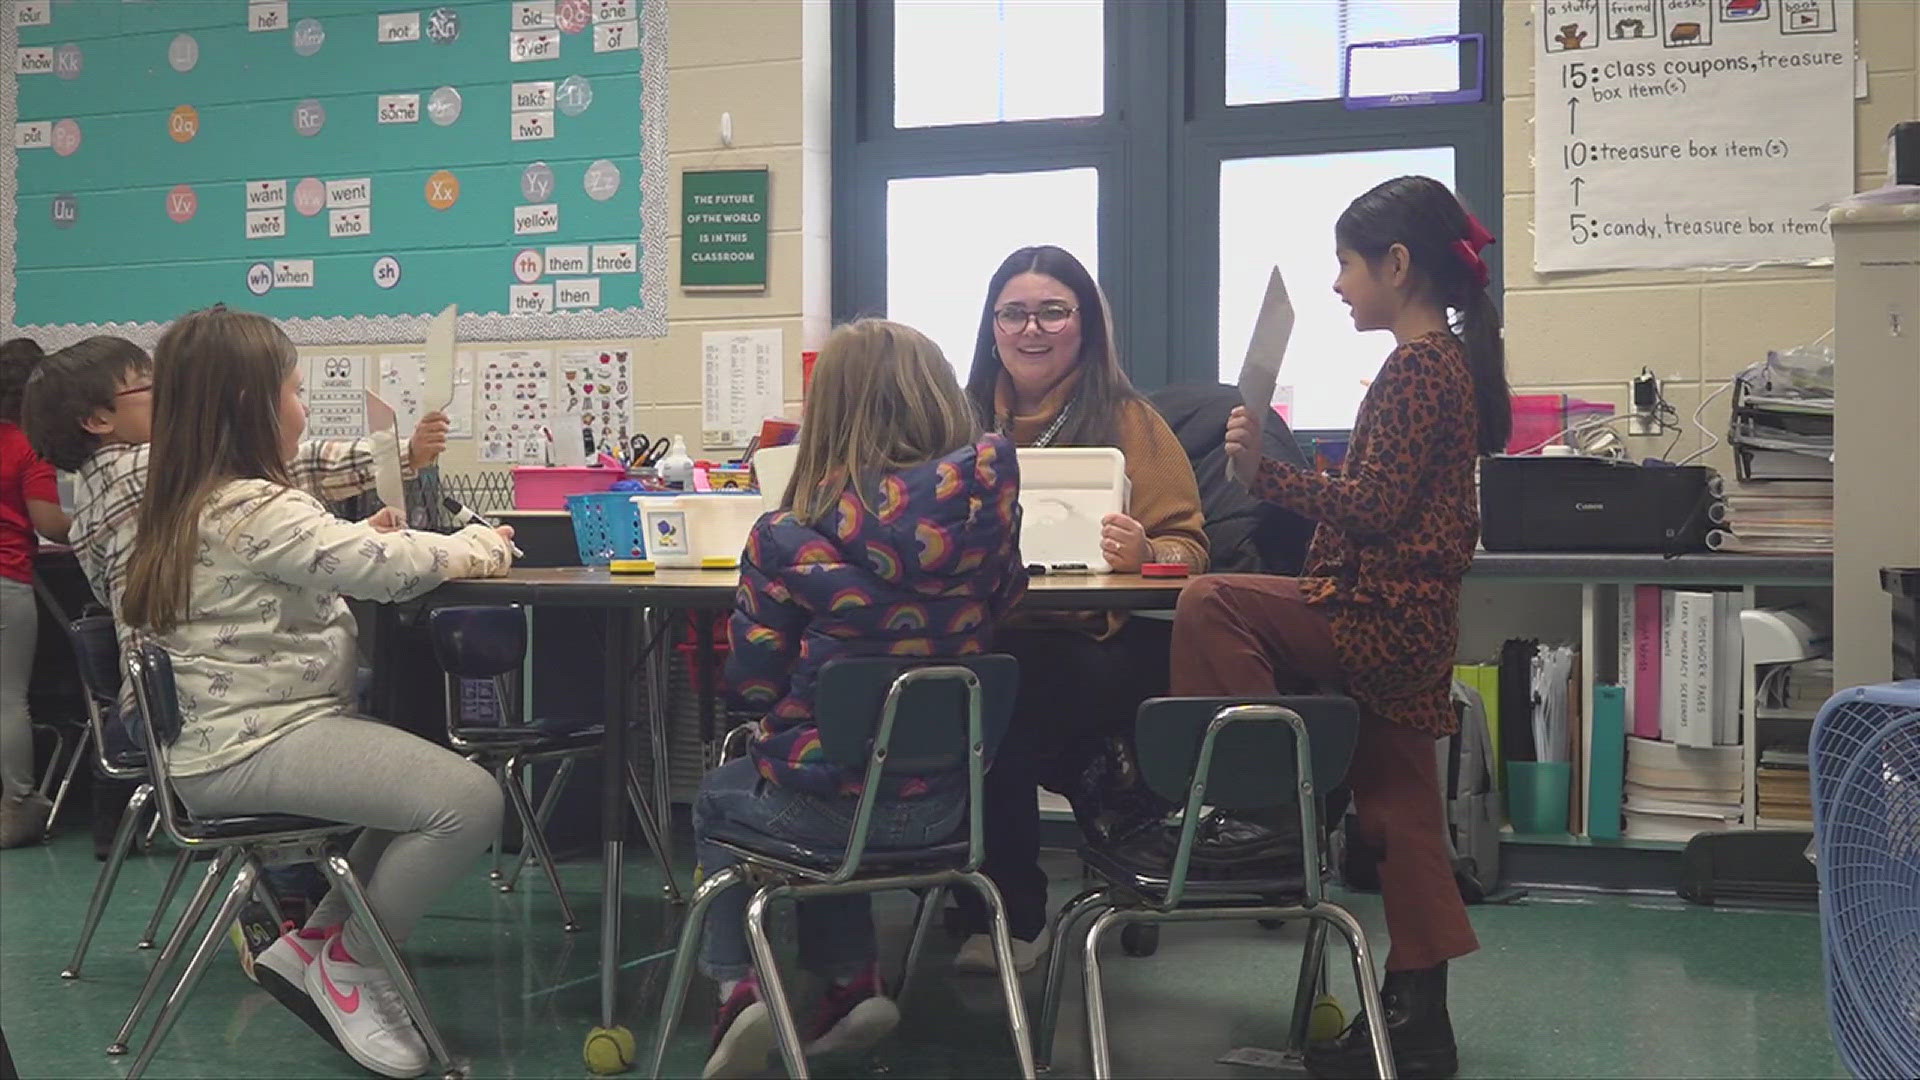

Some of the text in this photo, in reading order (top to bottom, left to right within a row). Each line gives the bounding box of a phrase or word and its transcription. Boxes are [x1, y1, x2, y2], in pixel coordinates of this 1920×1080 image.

[600, 6, 626, 18] one
[1547, 0, 1597, 15] a stuffy
[1611, 0, 1651, 13] friend
[19, 10, 42, 22] four
[258, 13, 278, 28] her
[522, 11, 542, 26] old
[388, 25, 410, 38] not
[607, 33, 621, 48] of
[517, 41, 550, 56] over
[22, 55, 50, 69] know
[57, 51, 79, 71] Kk
[1561, 62, 1599, 89] 15:
[1604, 60, 1656, 79] class
[1758, 50, 1843, 69] treasure
[1592, 77, 1688, 102] box item(s)
[517, 91, 546, 107] take
[298, 109, 320, 129] Rr
[379, 109, 416, 121] some
[172, 117, 196, 136] Qq
[519, 123, 543, 136] two
[23, 130, 42, 146] put
[57, 127, 75, 147] Pp
[1563, 139, 1789, 170] 10: treasure box item(s)
[331, 184, 366, 201] went
[432, 181, 452, 201] Xx
[526, 173, 549, 197] Yy
[250, 187, 283, 204] want
[693, 194, 755, 205] THE FUTURE
[54, 202, 74, 220] Uu
[172, 196, 192, 213] Vv
[516, 214, 557, 230] yellow
[687, 213, 761, 224] OF THE WORLD
[250, 221, 280, 234] were
[335, 220, 362, 233] who
[1570, 213, 1599, 245] 5:
[1603, 217, 1662, 239] candy,
[1664, 213, 1742, 235] treasure
[1749, 217, 1775, 234] box
[699, 233, 748, 243] IS IN THIS
[549, 256, 583, 271] them
[596, 255, 632, 270] three
[691, 252, 755, 261] CLASSROOM
[378, 263, 395, 280] sh
[520, 257, 537, 273] th
[250, 270, 269, 286] wh
[276, 269, 310, 284] when
[516, 294, 545, 311] they
[560, 288, 590, 303] then
[1575, 502, 1604, 512] Canon
[1680, 600, 1689, 625] EARLY
[1697, 615, 1708, 714] HOMEWORK PAGES
